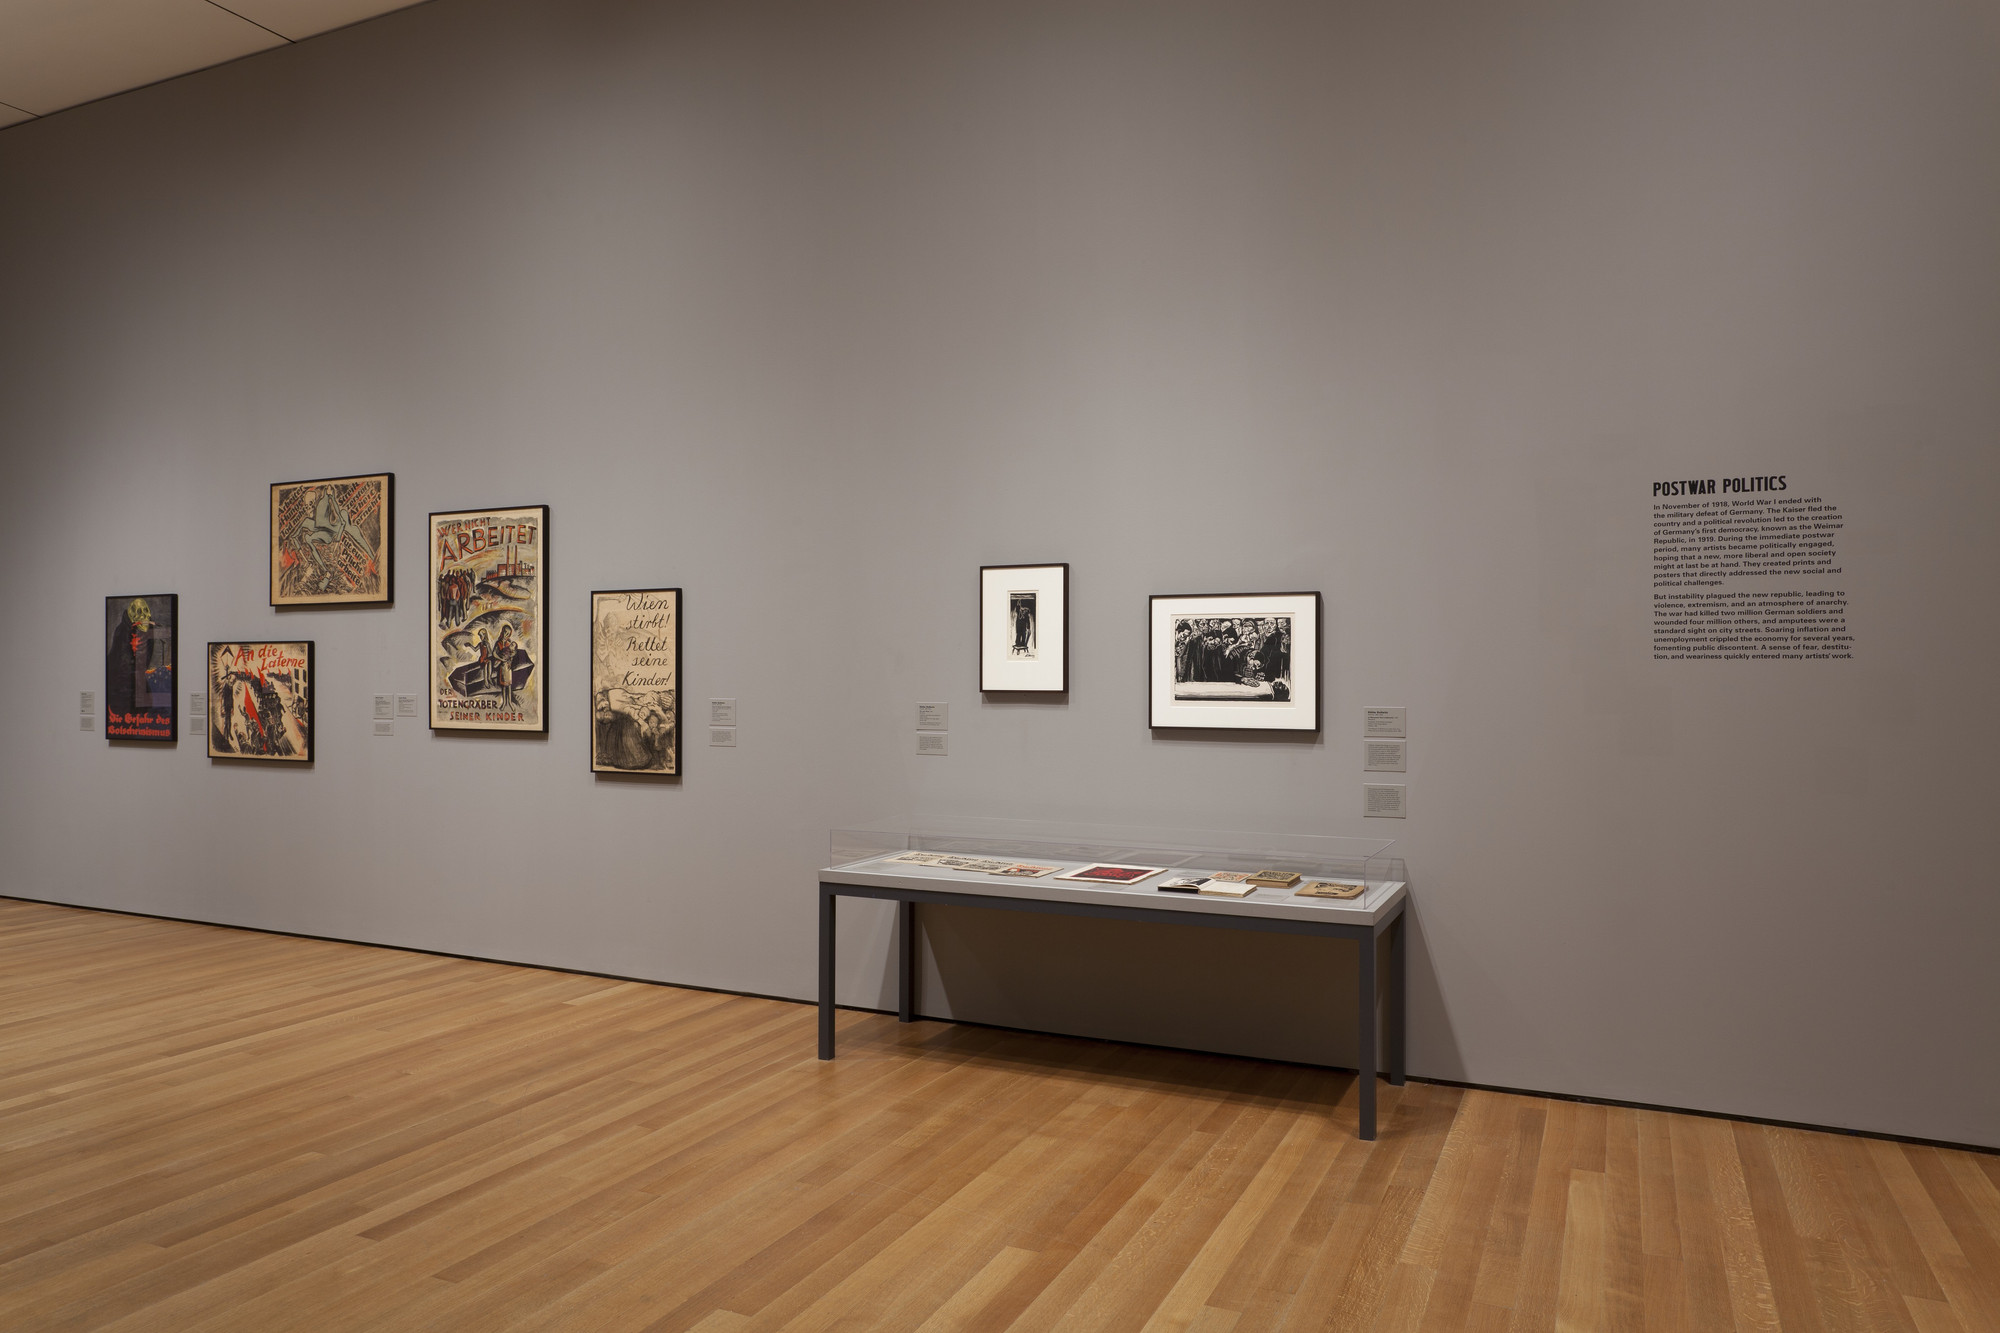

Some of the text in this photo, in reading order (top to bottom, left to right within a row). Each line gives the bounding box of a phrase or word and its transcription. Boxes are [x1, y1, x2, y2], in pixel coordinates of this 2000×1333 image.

[1653, 476, 1786, 496] POSTWAR POLITICS
[437, 517, 490, 537] WER NICHT
[440, 525, 537, 572] ARBEITET
[1760, 542, 1796, 550] politically
[626, 593, 669, 610] Wien
[626, 613, 670, 630] stirbt!
[626, 636, 668, 652] Rettet
[234, 644, 278, 666] An die
[261, 650, 305, 671] Laterne
[632, 654, 668, 666] seine
[622, 671, 672, 686] Kinder!
[450, 712, 524, 722] SEINER KINDER
